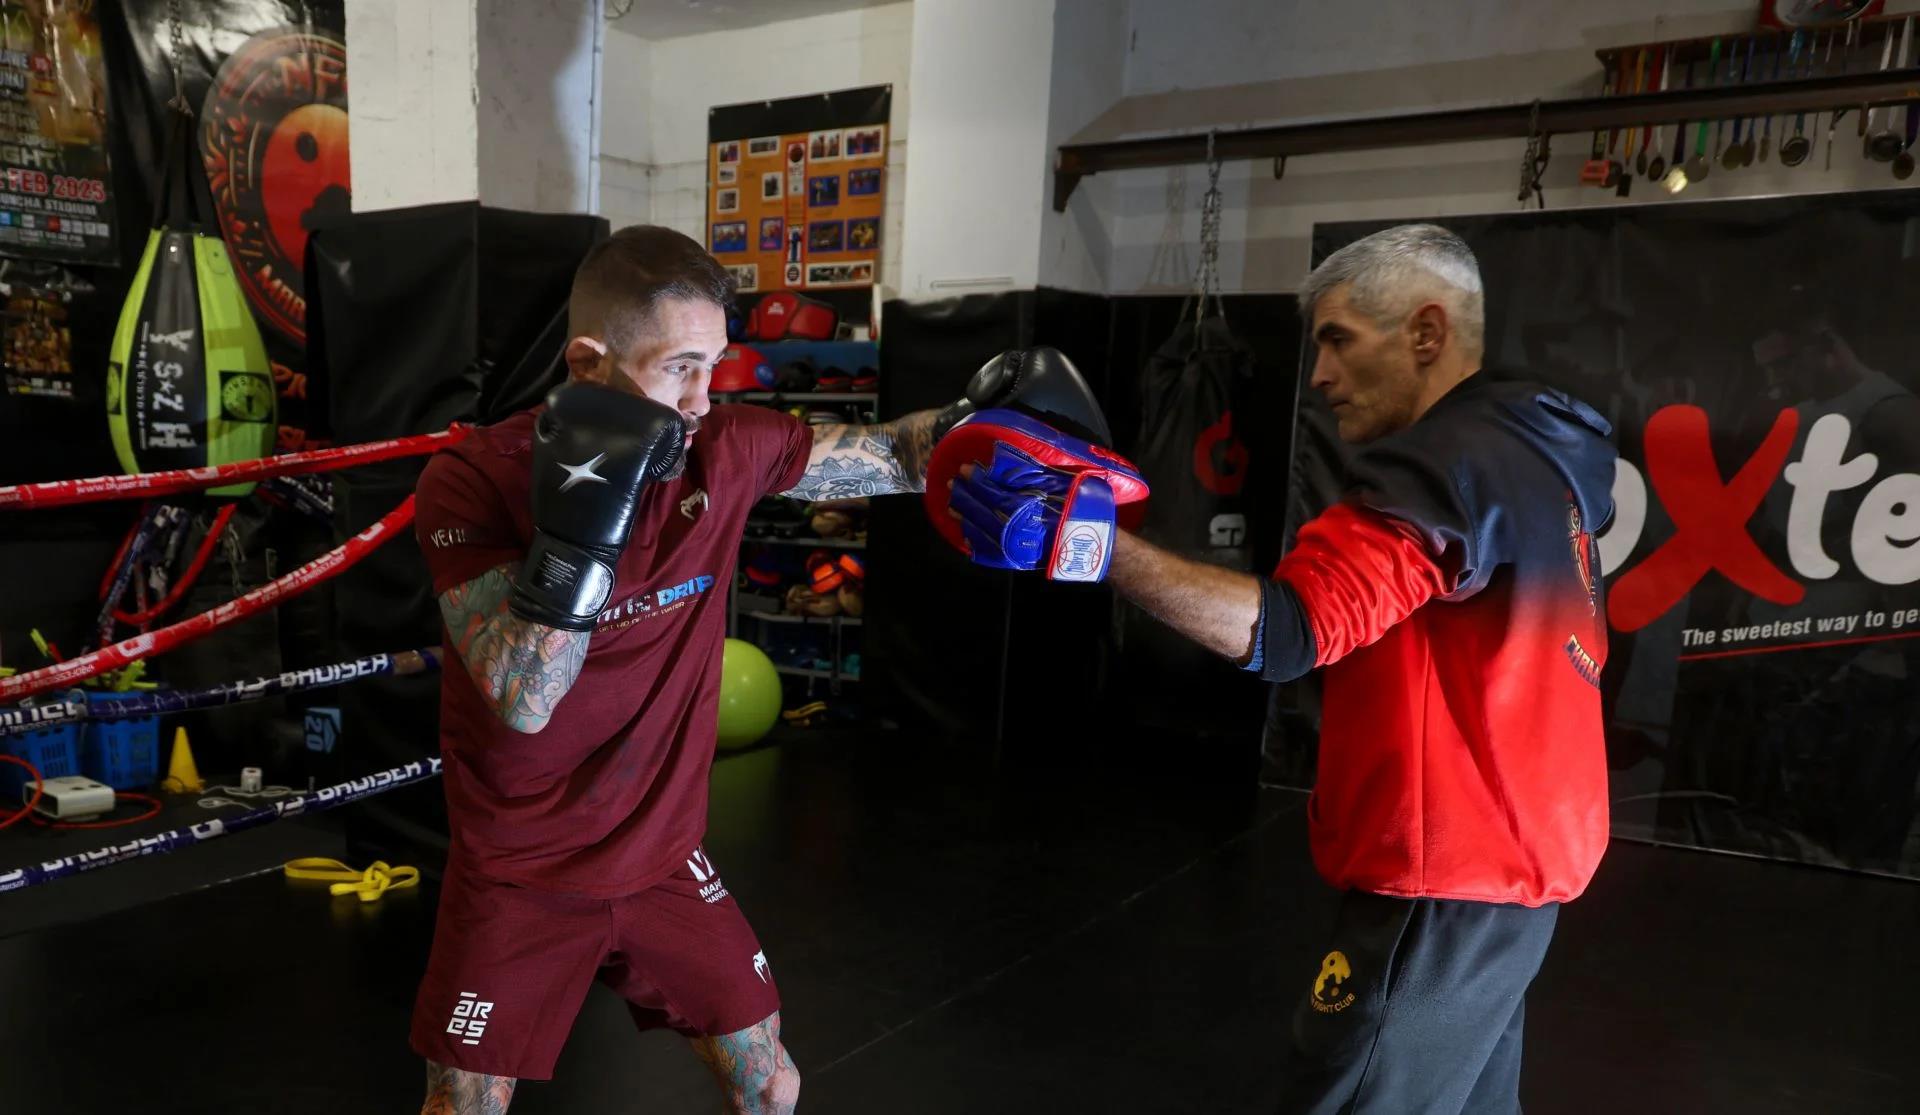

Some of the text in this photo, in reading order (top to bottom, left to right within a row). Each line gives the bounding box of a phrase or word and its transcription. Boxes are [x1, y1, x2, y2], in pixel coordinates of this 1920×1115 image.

[52, 174, 107, 204] 2025
[656, 575, 714, 607] DRIP
[1682, 607, 1920, 647] The sweetest way to ge
